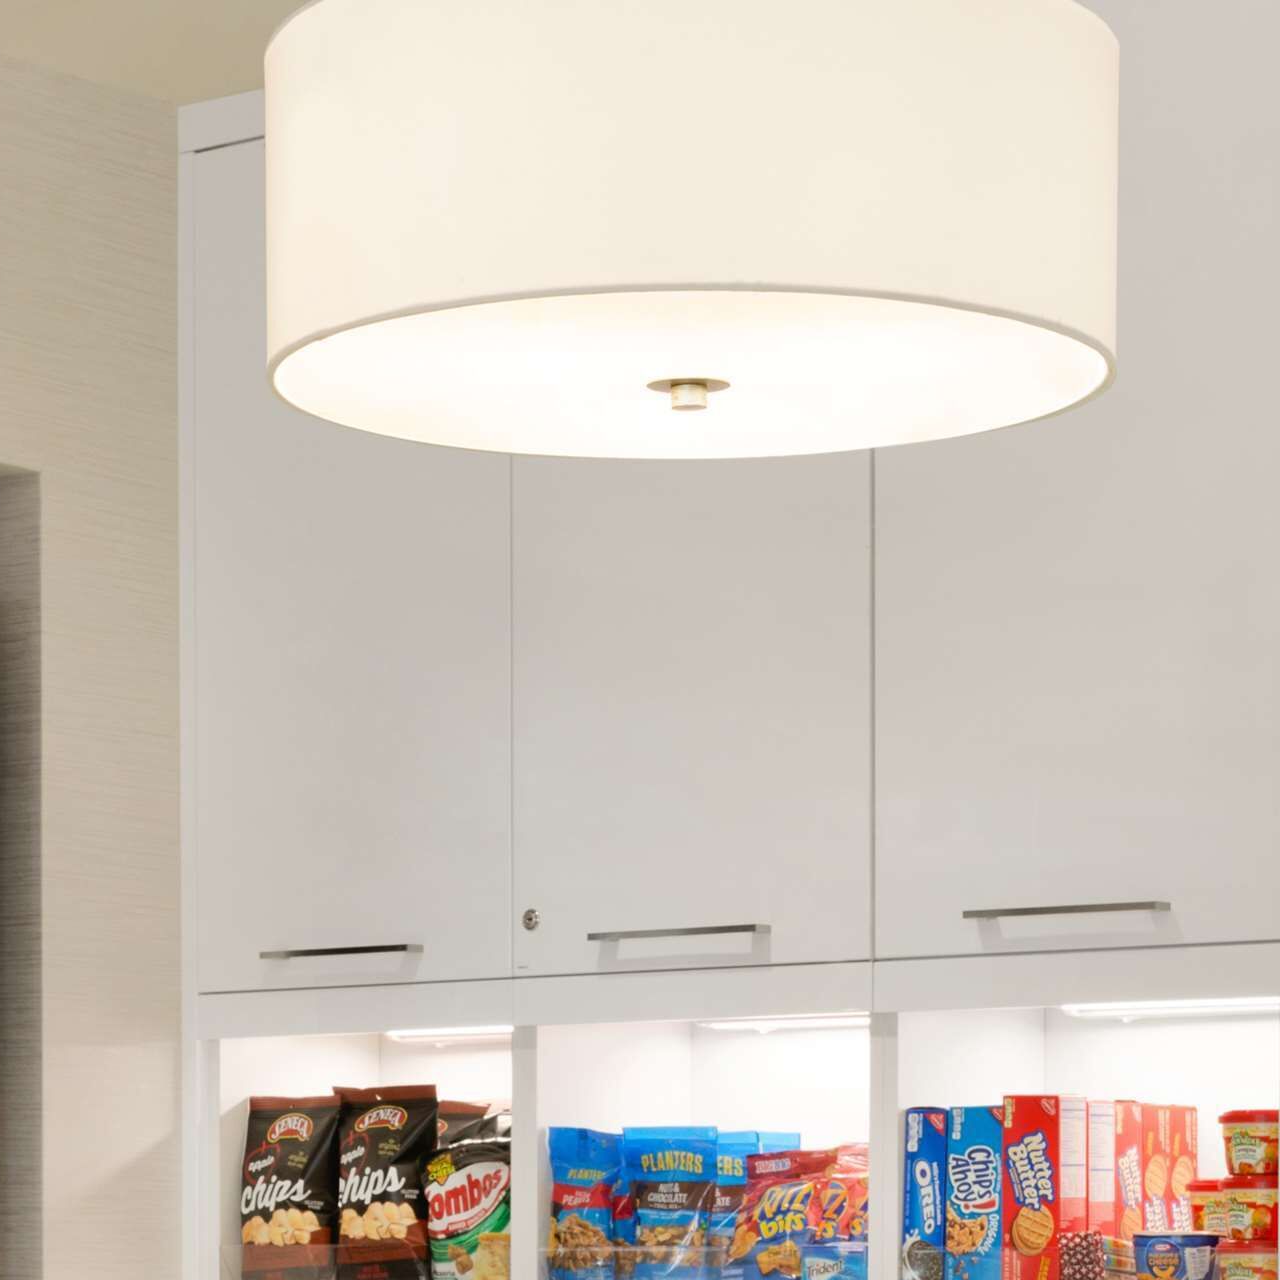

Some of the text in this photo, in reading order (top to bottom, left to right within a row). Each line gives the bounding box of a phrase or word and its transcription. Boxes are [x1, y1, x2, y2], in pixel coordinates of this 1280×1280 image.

[640, 1151, 704, 1175] PLANTERS
[968, 1146, 996, 1200] Chips
[1008, 1144, 1041, 1210] Butter
[1023, 1133, 1054, 1201] Nutter
[241, 1175, 312, 1215] chips
[429, 1169, 503, 1222] ombos
[914, 1160, 935, 1236] OREO
[978, 1213, 1000, 1256] ORIGINAL
[807, 1261, 844, 1279] Trident
